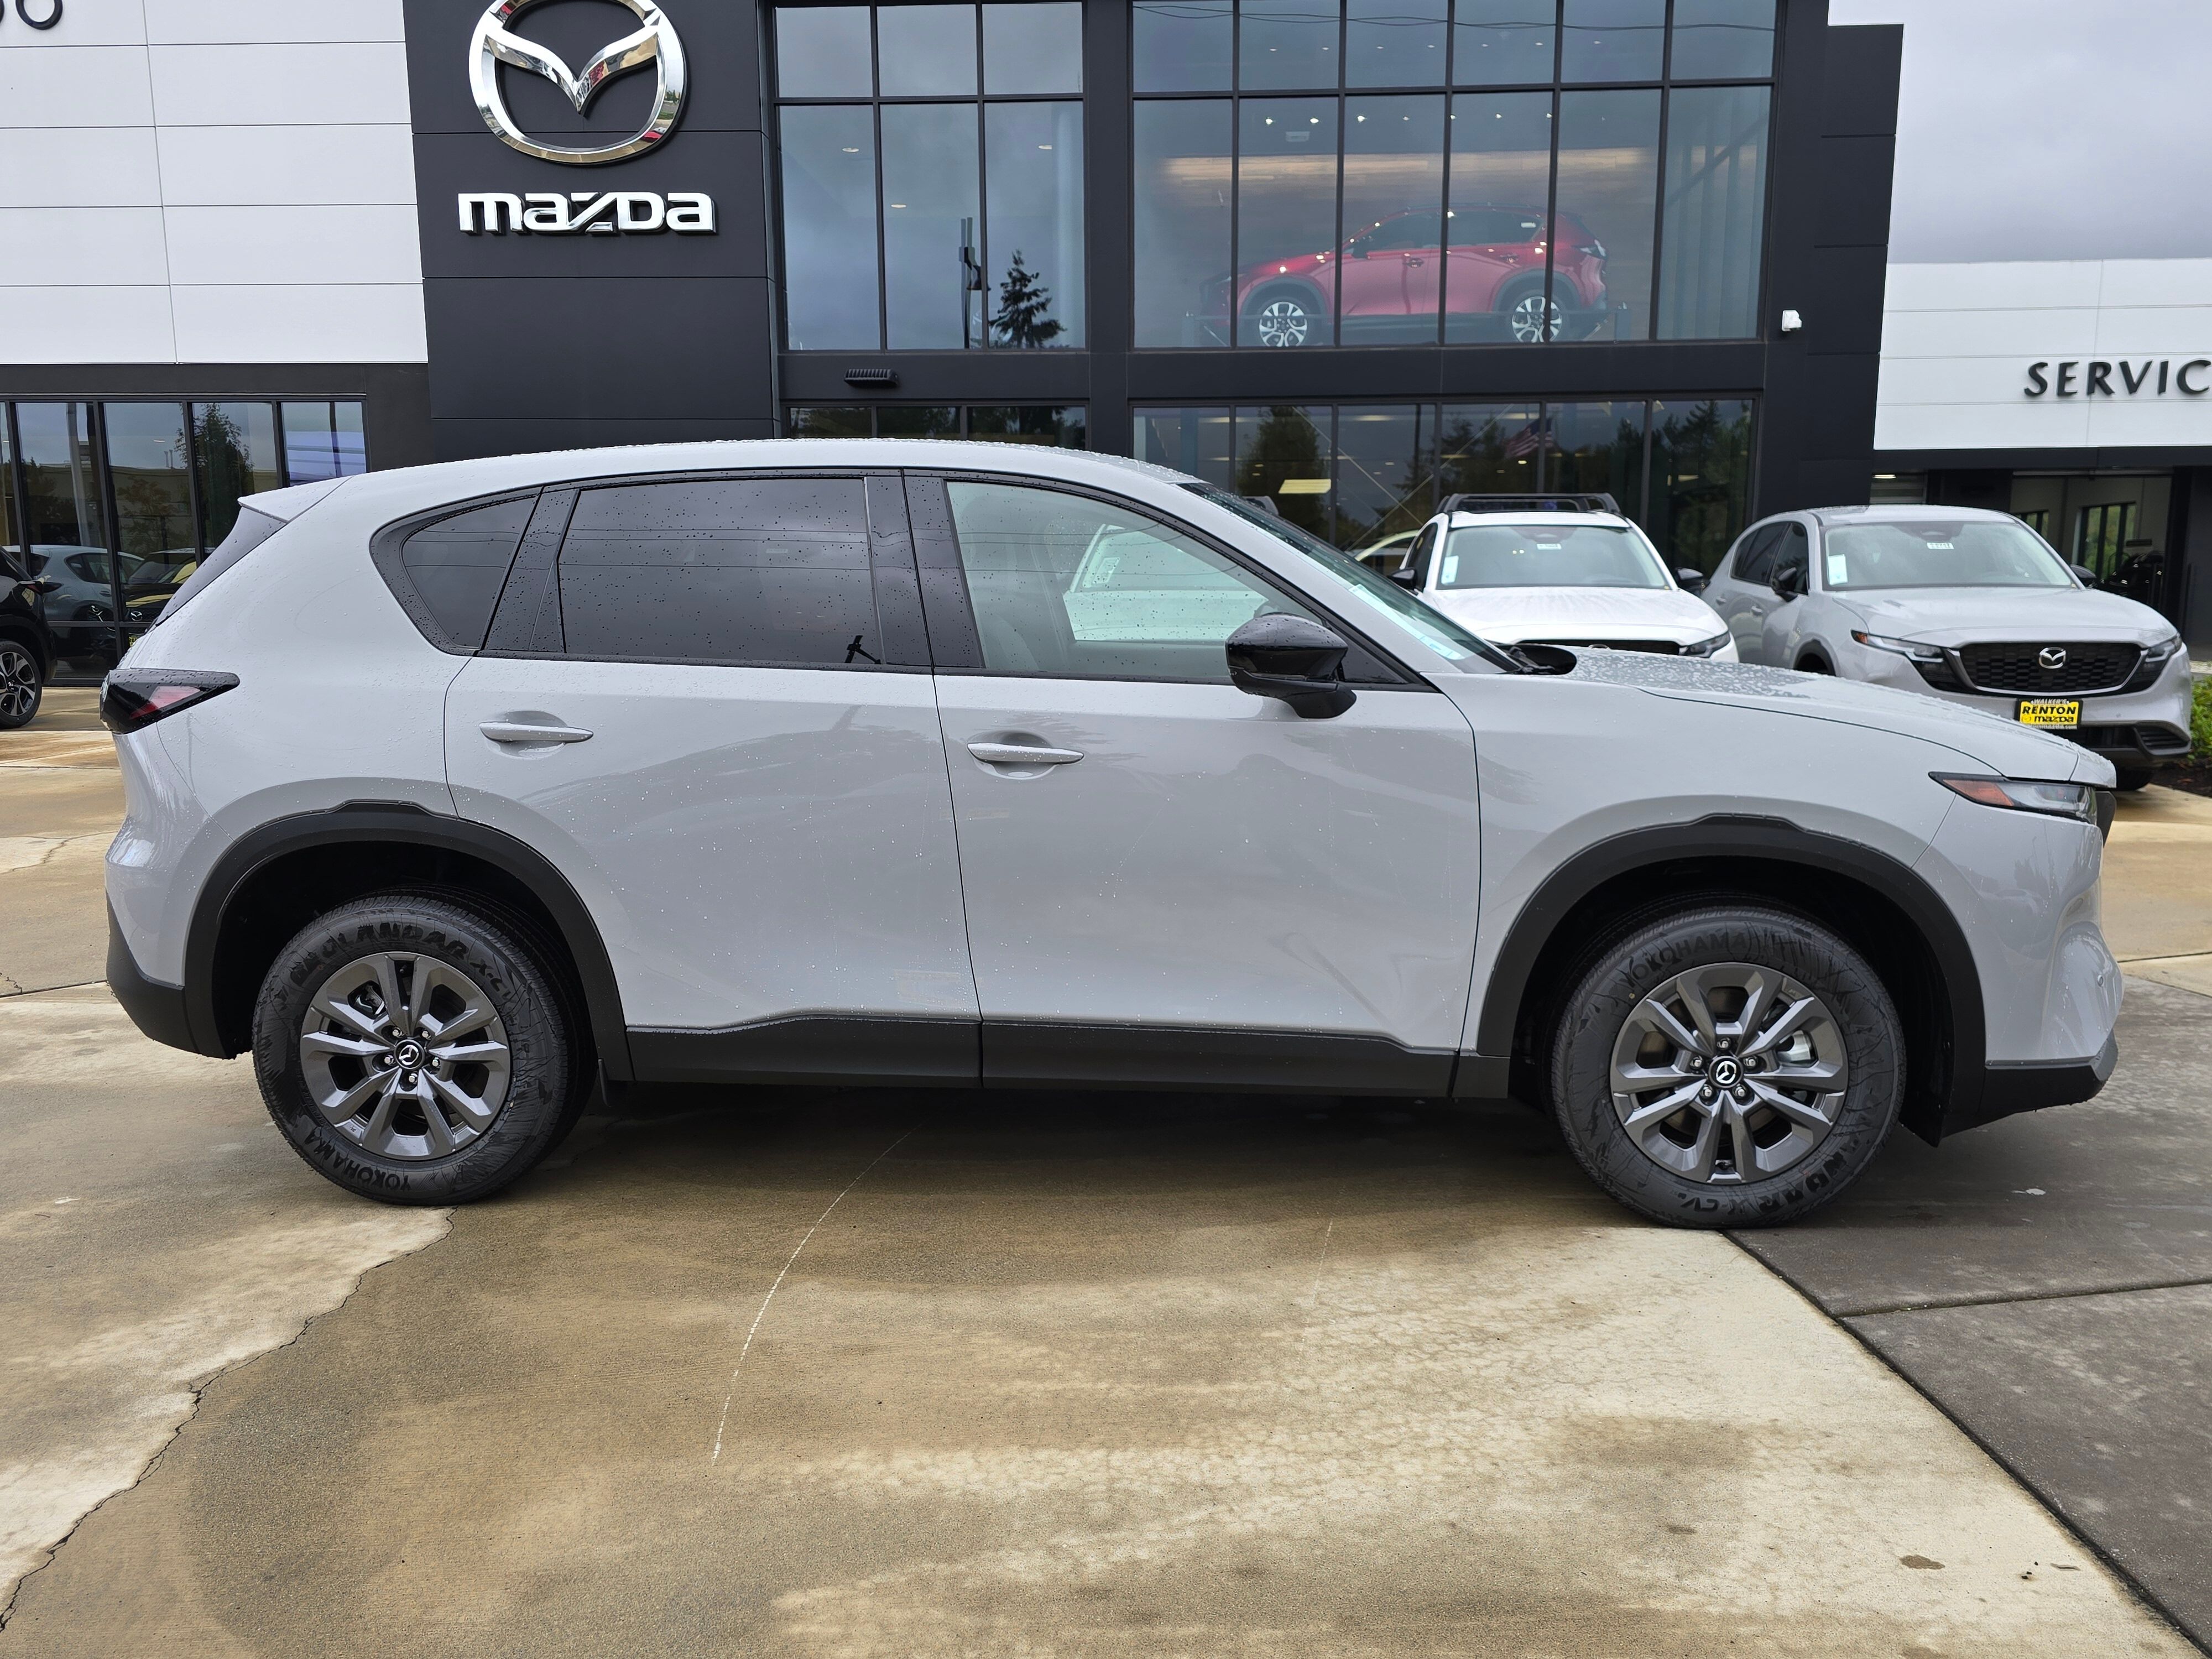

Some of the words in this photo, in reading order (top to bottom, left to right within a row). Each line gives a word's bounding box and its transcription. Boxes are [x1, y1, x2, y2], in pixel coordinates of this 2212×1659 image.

[2023, 359, 2212, 397] SERVIC
[2022, 706, 2076, 714] RENTON
[1619, 931, 1750, 988] YOKOHAMA
[304, 1126, 411, 1191] YOKOHAMA
